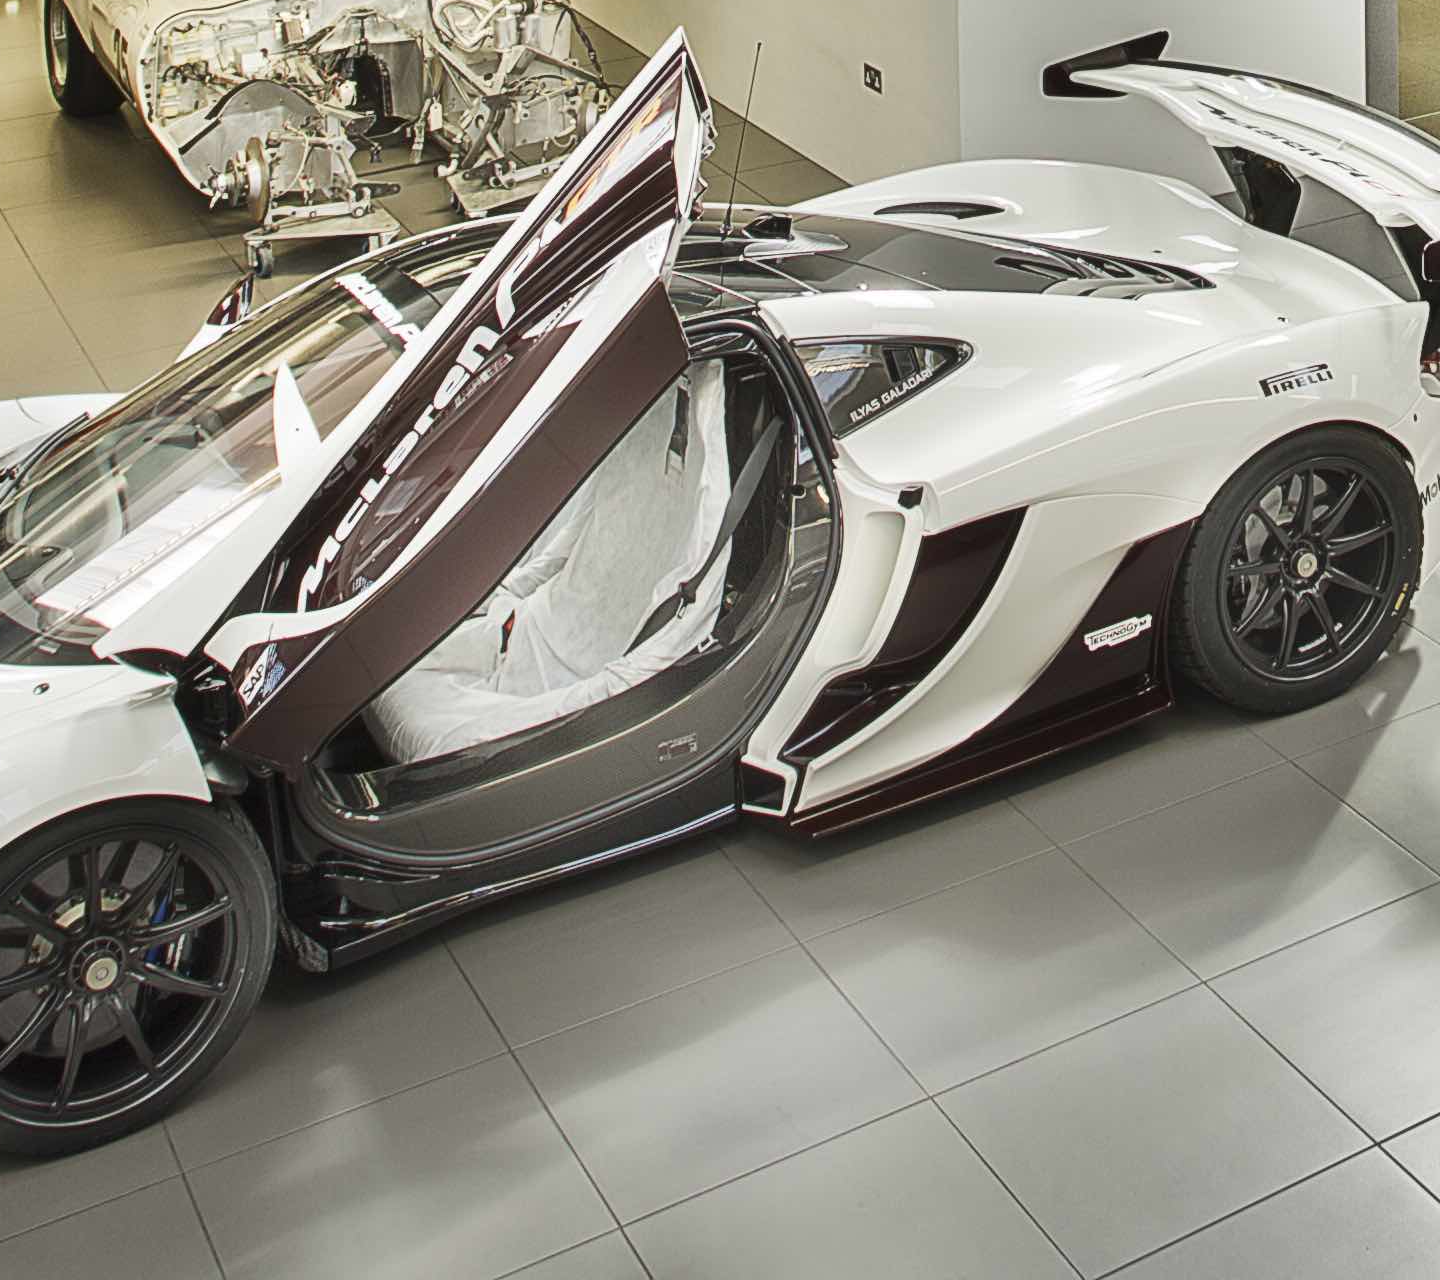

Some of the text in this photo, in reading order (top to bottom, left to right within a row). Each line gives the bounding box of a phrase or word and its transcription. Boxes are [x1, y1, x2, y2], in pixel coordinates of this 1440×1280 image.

[849, 398, 881, 423] ILYAS
[880, 368, 934, 405] GALADARI
[1258, 364, 1334, 397] PIRELLI
[297, 325, 501, 612] McLaren
[242, 663, 265, 699] SAP
